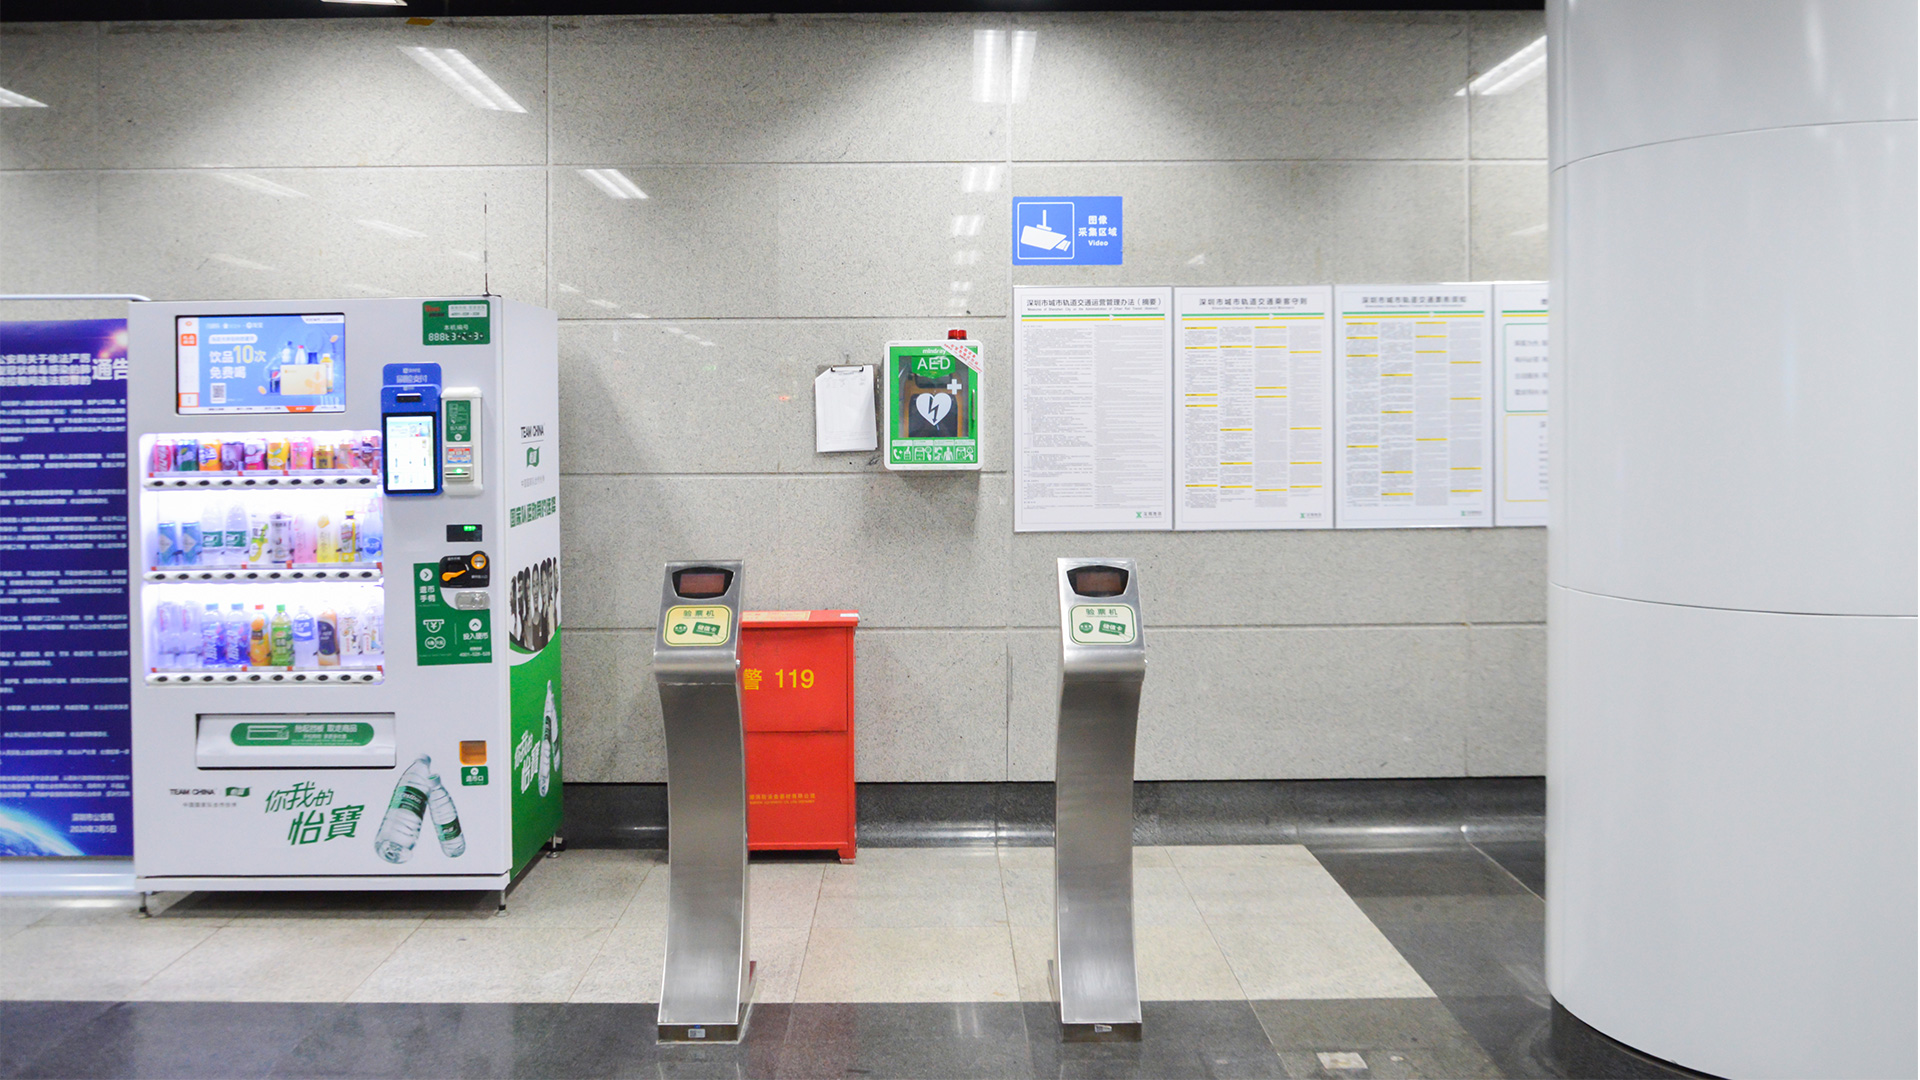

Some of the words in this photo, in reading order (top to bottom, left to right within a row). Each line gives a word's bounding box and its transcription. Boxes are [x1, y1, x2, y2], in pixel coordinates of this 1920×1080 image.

[1088, 215, 1108, 225] 图像
[1078, 227, 1117, 237] 采集区域
[209, 345, 267, 364] 饮品10次
[917, 357, 951, 370] AED
[210, 366, 247, 379] 免费喝
[683, 609, 715, 617] 验票机
[743, 668, 762, 690] 警
[775, 668, 815, 689] 119
[169, 788, 190, 796] TEAM
[192, 788, 216, 796] CHINA
[265, 781, 334, 814] 你我的
